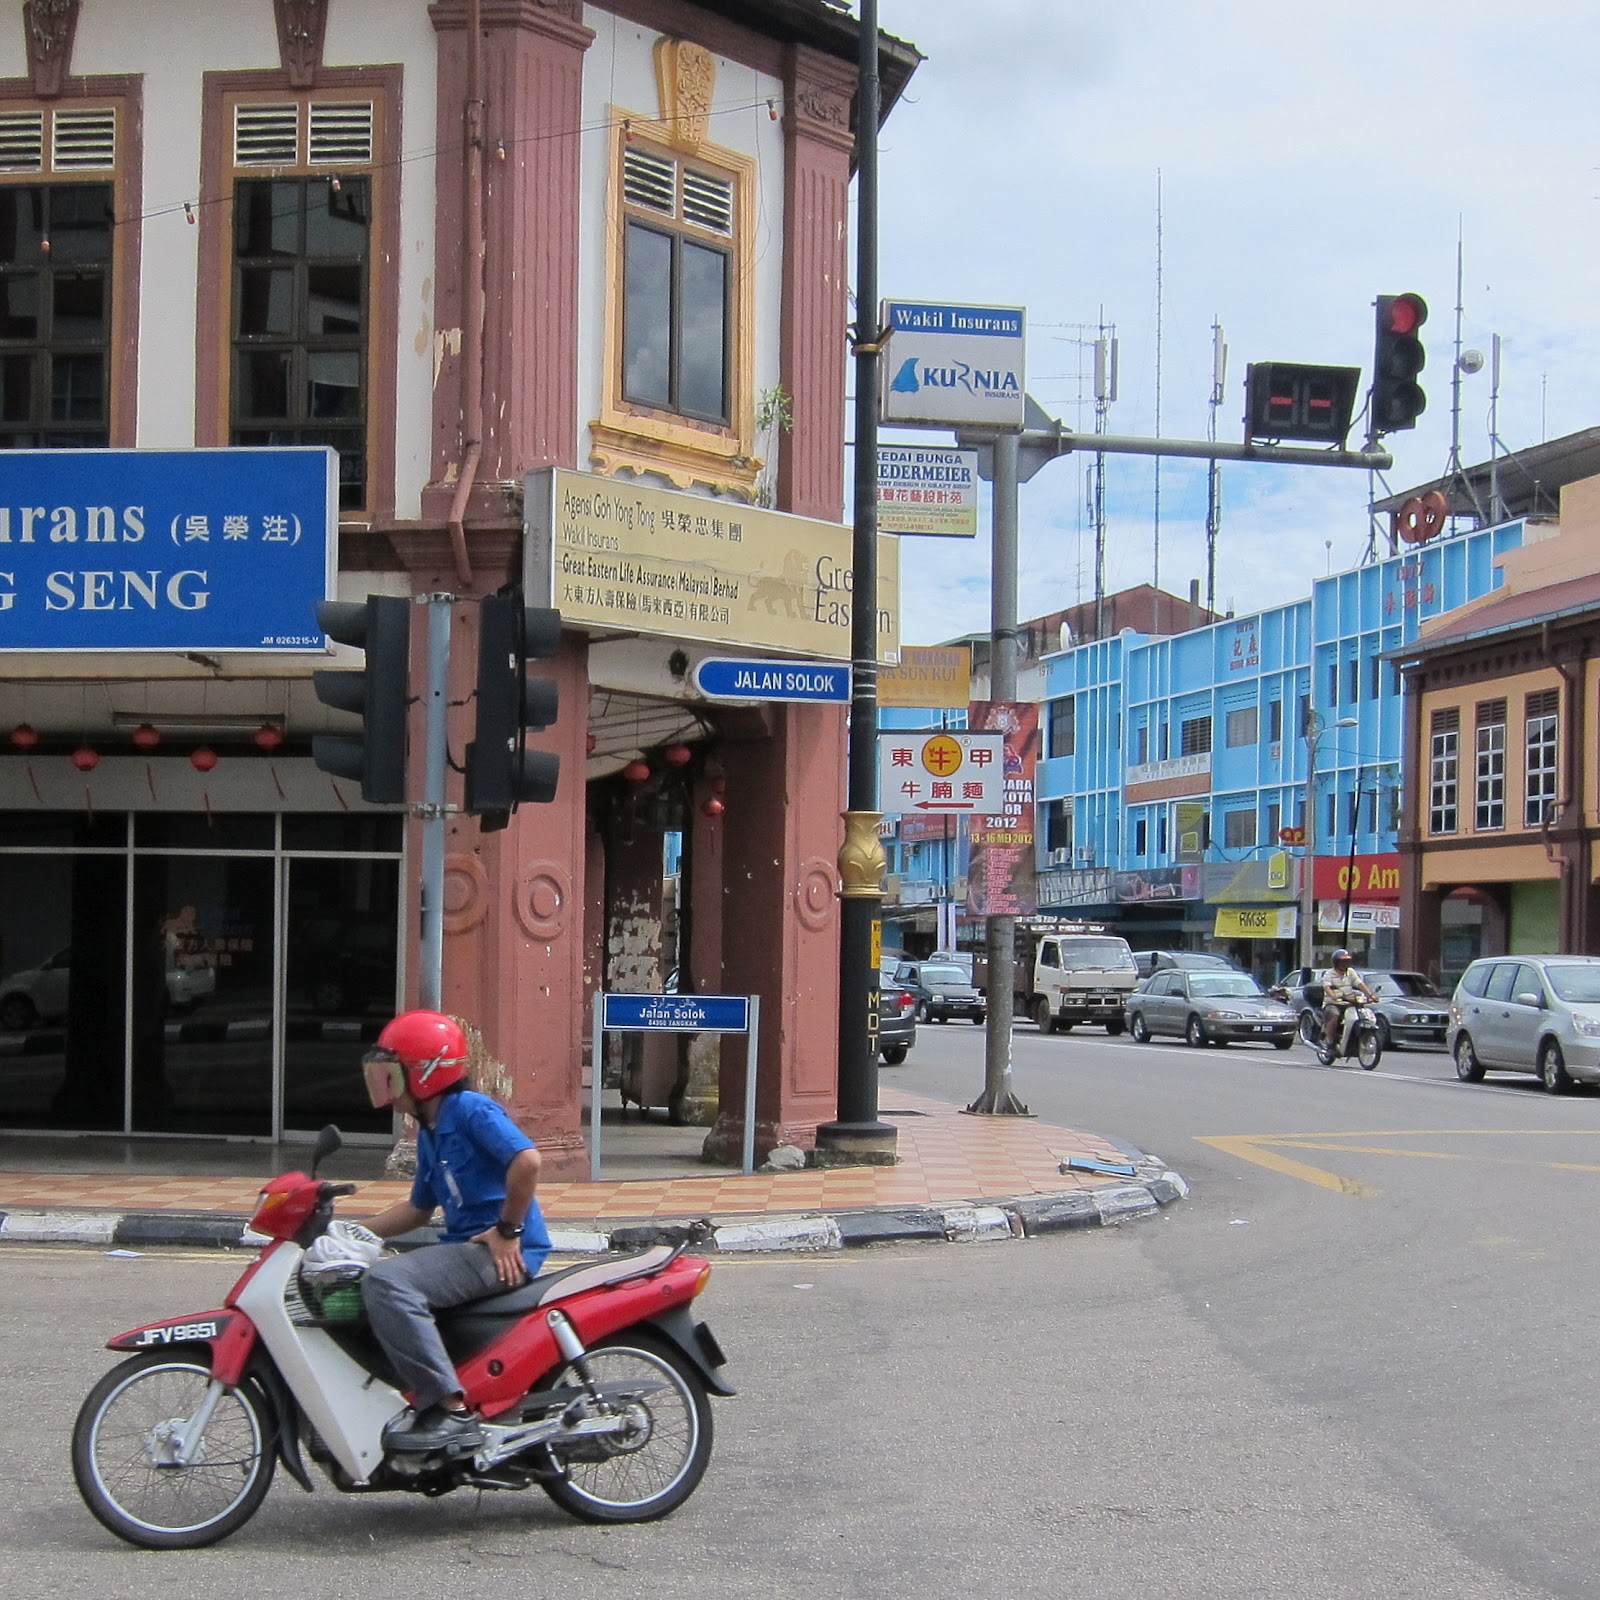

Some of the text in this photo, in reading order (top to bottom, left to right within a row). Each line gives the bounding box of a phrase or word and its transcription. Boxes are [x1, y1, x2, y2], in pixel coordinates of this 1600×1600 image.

[896, 309, 1018, 332] Wakil Insurans
[923, 359, 1019, 396] KURNIA
[984, 391, 1020, 399] INSURANS
[916, 453, 962, 464] BUNGA
[877, 464, 971, 482] EDERMEIER
[563, 488, 655, 534] Agensi Goh Yong Tong
[563, 522, 619, 550] Wakil Insurans
[562, 552, 585, 576] Great
[587, 556, 618, 581] Eastern
[619, 561, 634, 583] Life
[636, 565, 675, 590] Assurance
[713, 575, 739, 600] Berhad
[816, 556, 854, 592] Gre
[45, 570, 211, 611] SENG
[815, 587, 891, 633] Easn
[261, 636, 320, 645] JM 0263215-V
[734, 671, 834, 692] JALAN SOLOK
[900, 667, 928, 681] SUN
[932, 667, 956, 681] KUI
[891, 748, 914, 767] 東
[969, 749, 993, 769] 甲
[900, 781, 984, 799] 牛腩麵
[1004, 804, 1022, 815] OR
[986, 817, 1018, 828] 2012
[970, 833, 980, 843] 13
[986, 833, 995, 843] 16
[997, 833, 1012, 843] MEI
[1012, 834, 1032, 844] 2012
[1239, 912, 1267, 927] RM38
[639, 1008, 706, 1019] Jalan Solok
